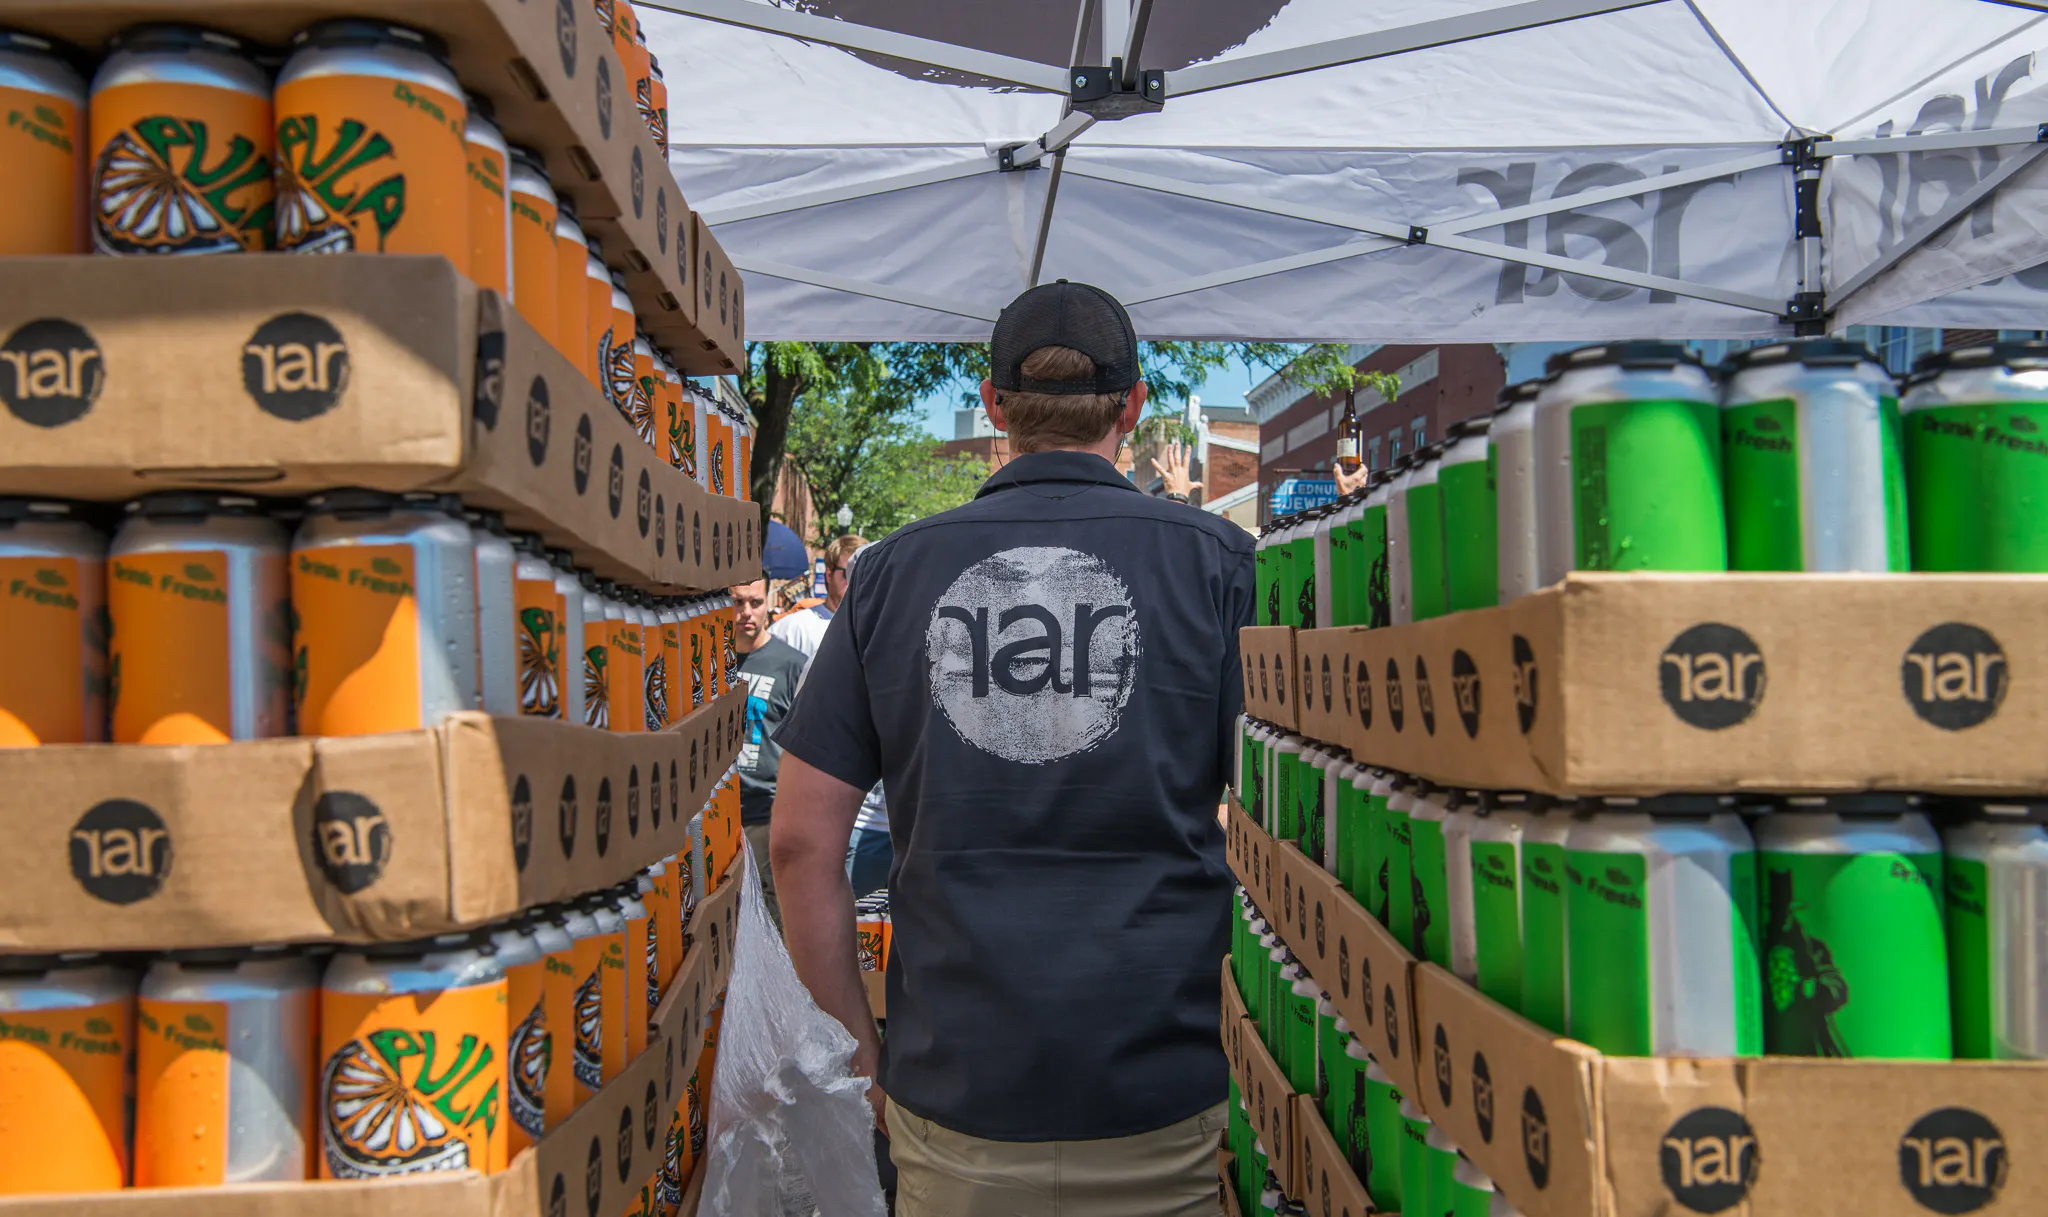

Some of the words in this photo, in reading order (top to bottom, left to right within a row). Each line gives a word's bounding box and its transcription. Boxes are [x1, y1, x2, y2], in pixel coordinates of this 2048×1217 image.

[0, 348, 99, 400] rar
[245, 341, 345, 394] rar
[938, 603, 1127, 698] rar
[1664, 652, 1761, 701] rar
[1906, 652, 2003, 701] rar
[72, 827, 169, 877] rar
[1664, 1135, 1756, 1187] rar
[1903, 1136, 2001, 1187] rar
